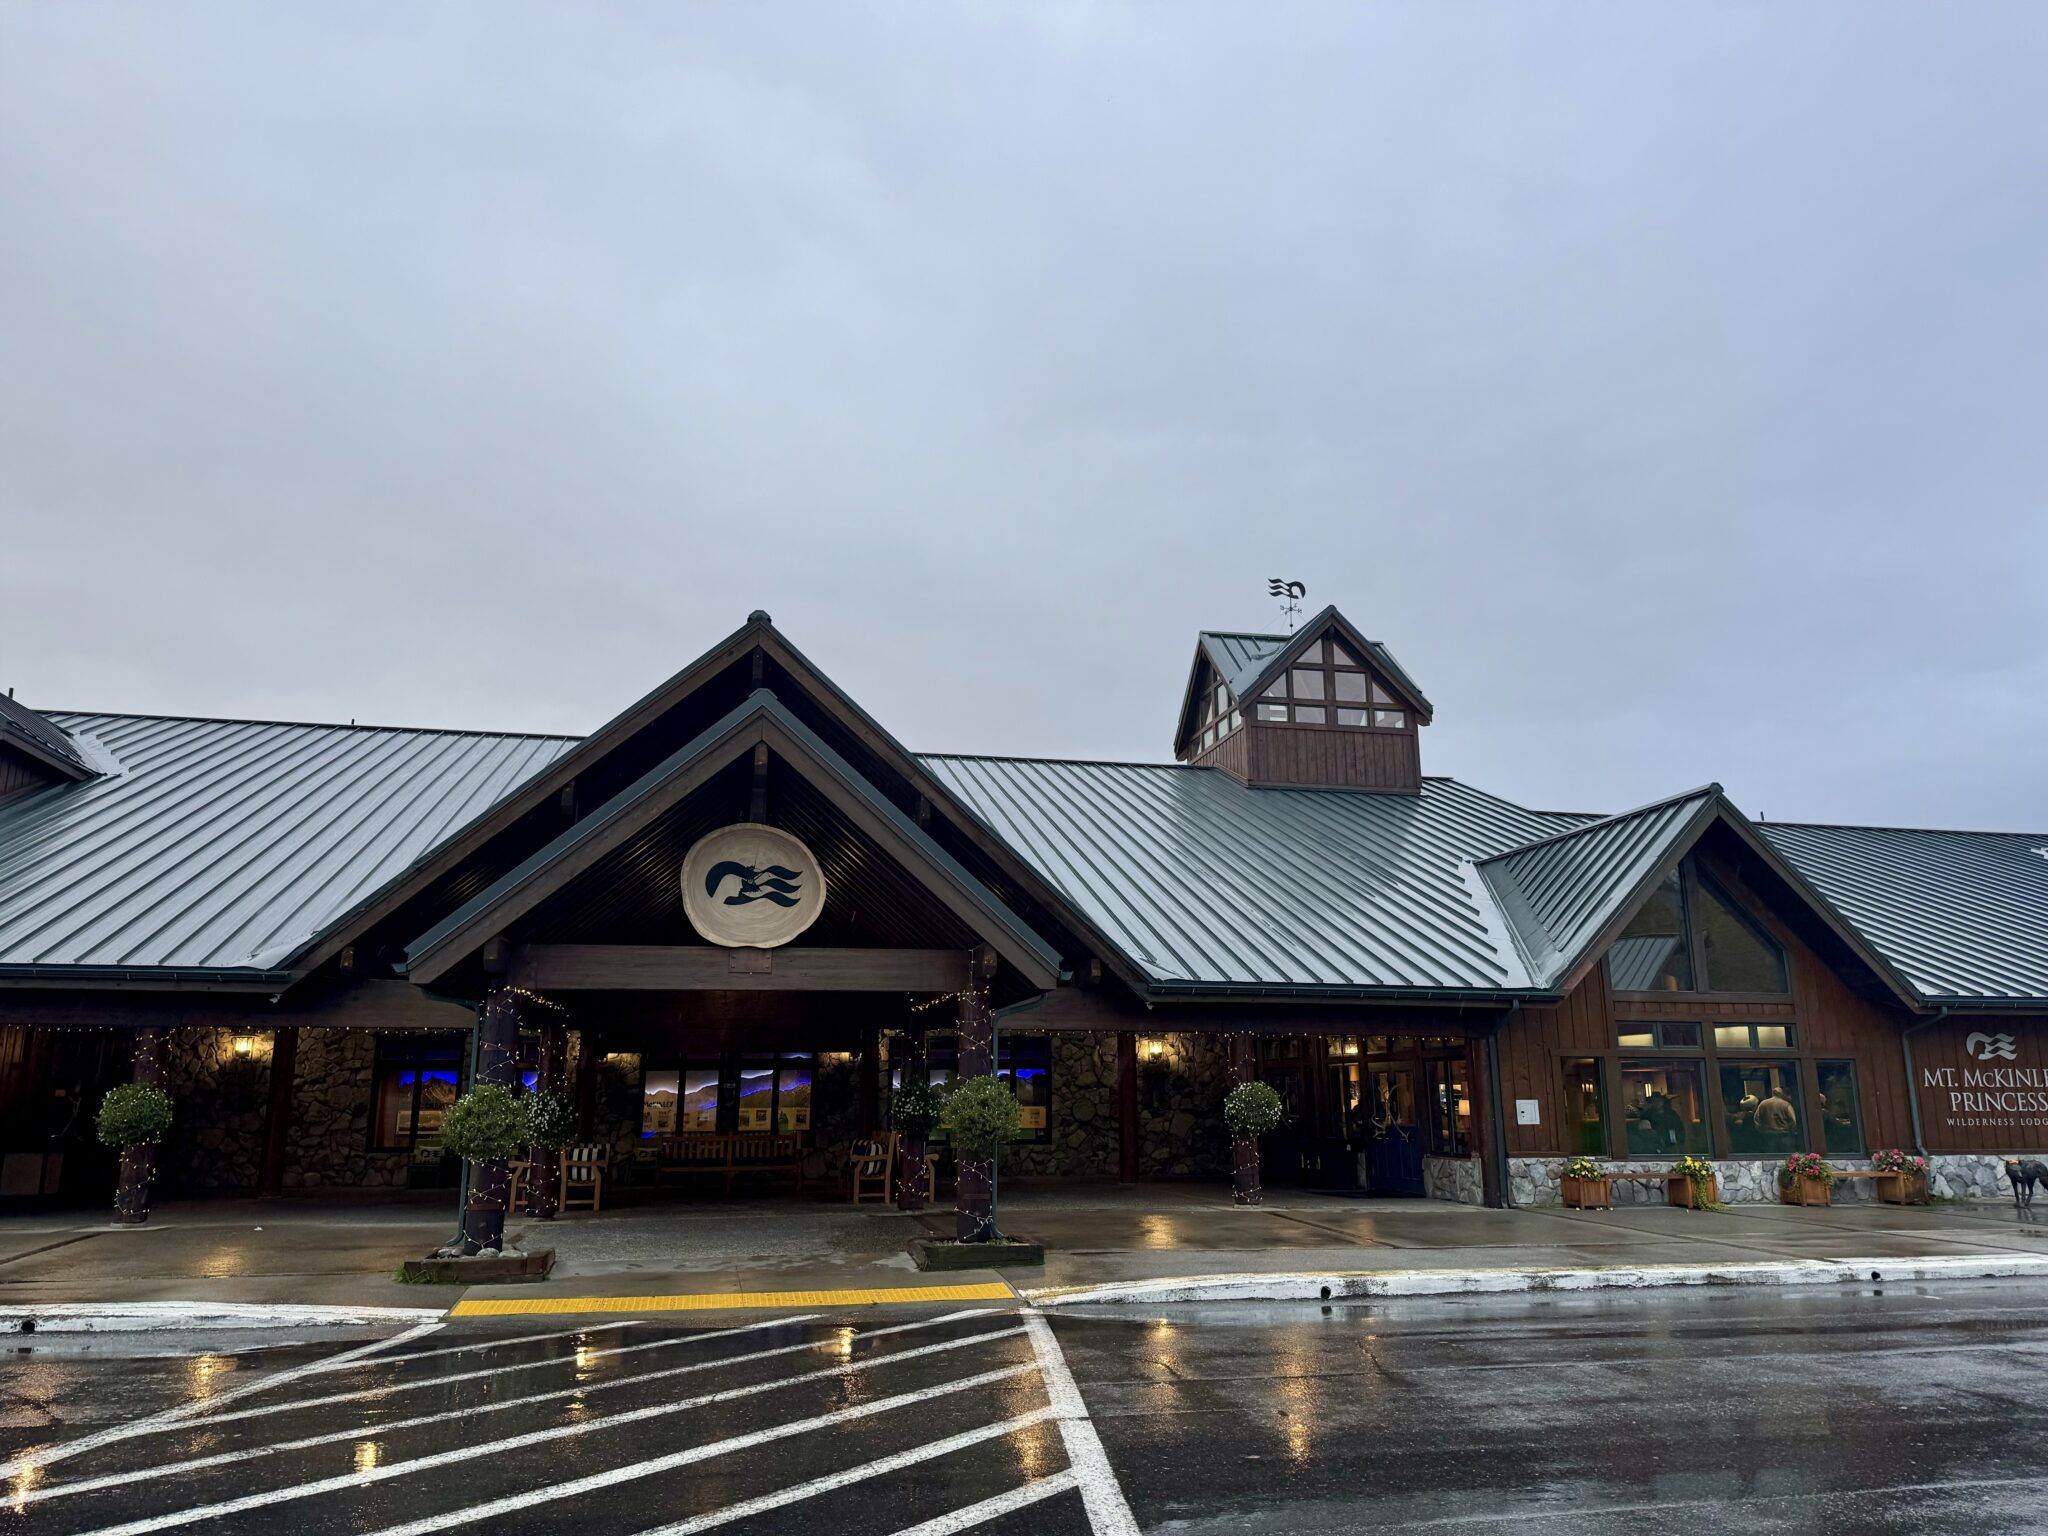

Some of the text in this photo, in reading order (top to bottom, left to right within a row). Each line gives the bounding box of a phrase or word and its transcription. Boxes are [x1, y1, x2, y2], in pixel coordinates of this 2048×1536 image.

[1924, 1068, 1959, 1087] MT.
[1950, 1092, 2048, 1112] PRINCESS
[1946, 1117, 2015, 1126] WILDERNESS
